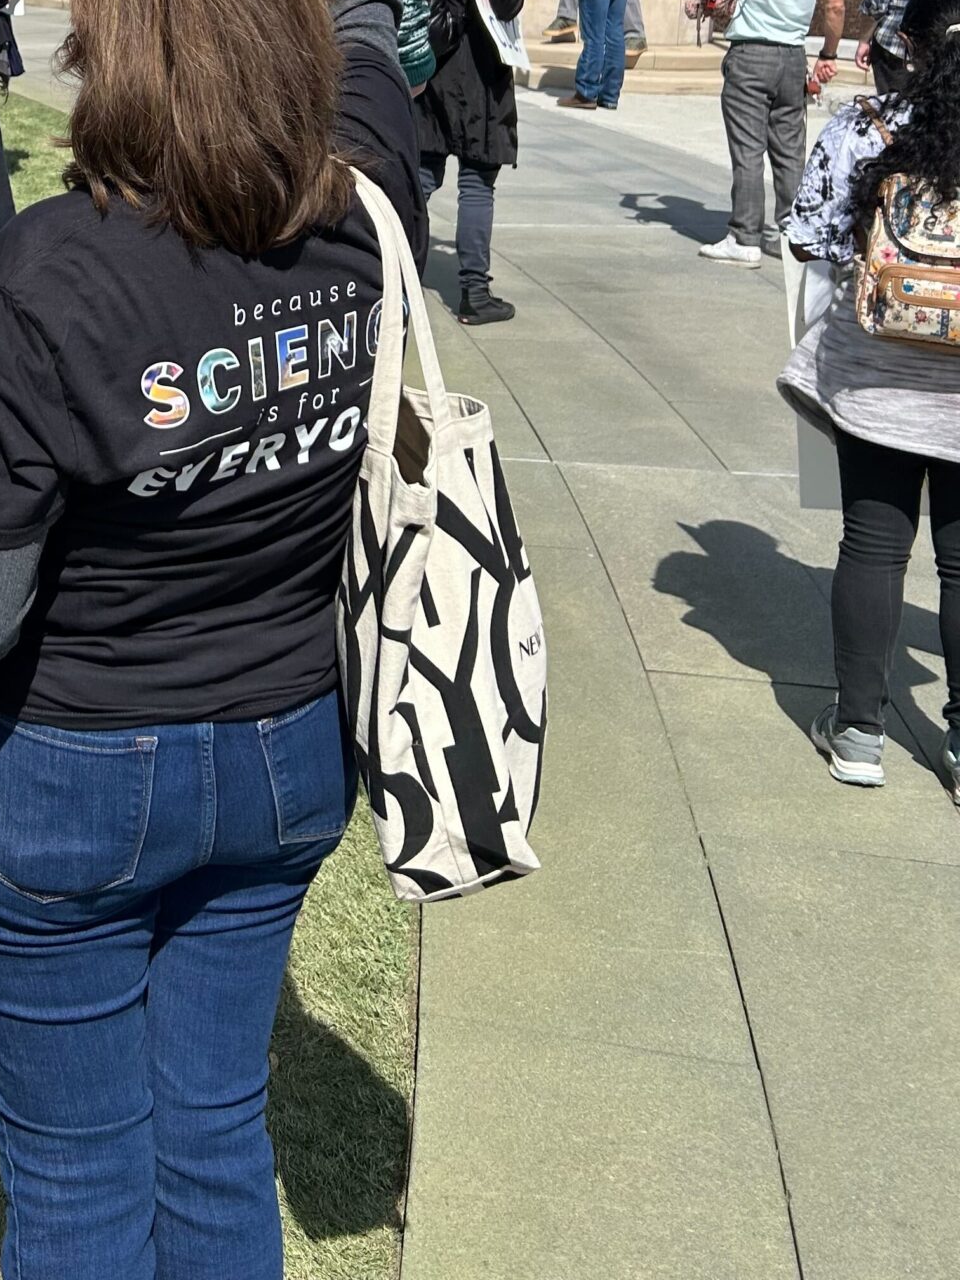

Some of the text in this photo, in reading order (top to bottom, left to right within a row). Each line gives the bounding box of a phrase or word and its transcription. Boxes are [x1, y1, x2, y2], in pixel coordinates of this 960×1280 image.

[233, 280, 357, 326] because
[257, 386, 340, 425] is for
[127, 405, 368, 497] EVERYO
